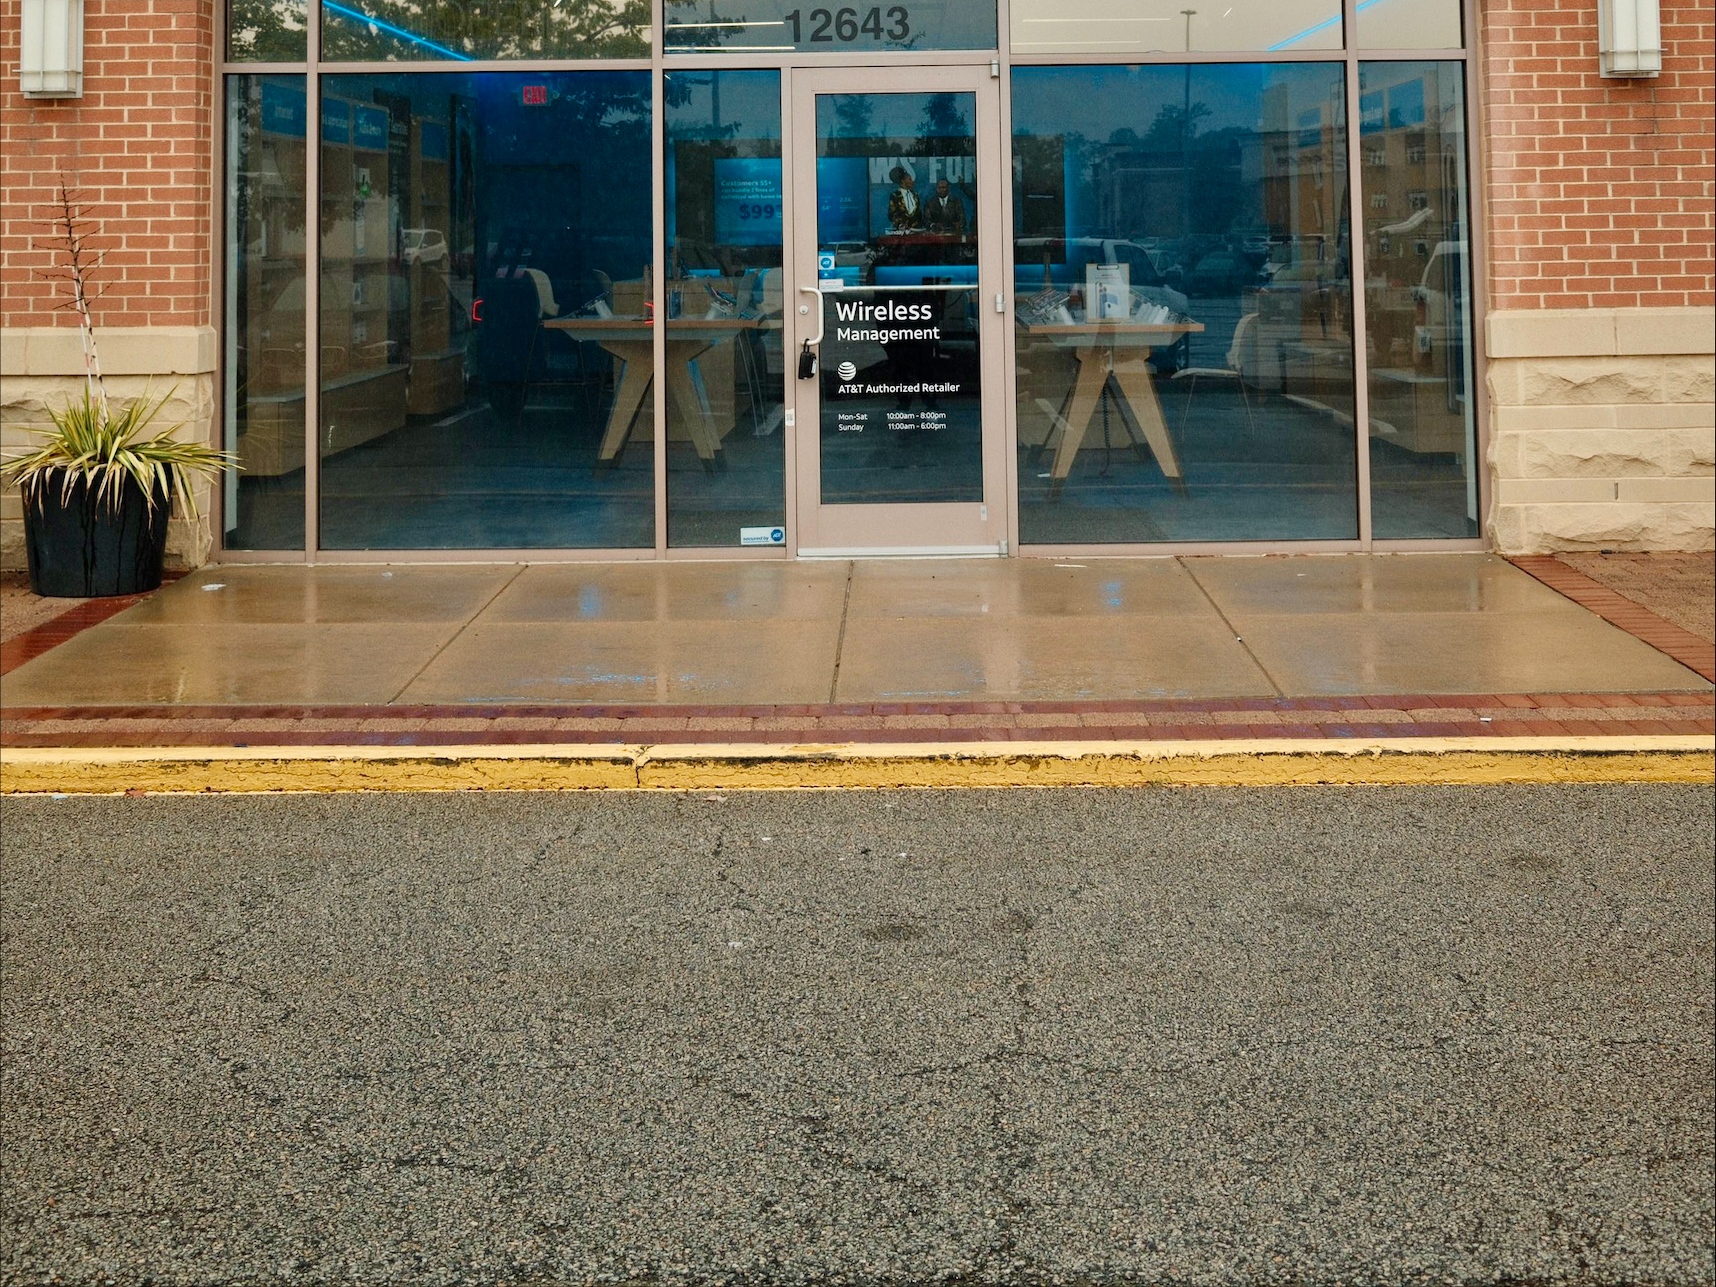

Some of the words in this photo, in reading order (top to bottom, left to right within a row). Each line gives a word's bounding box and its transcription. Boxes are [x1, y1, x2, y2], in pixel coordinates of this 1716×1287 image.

[785, 6, 910, 43] 12643
[523, 85, 547, 105] EXIT
[835, 300, 932, 322] Wireless
[837, 326, 941, 344] Management
[838, 384, 864, 394] AT&T
[865, 383, 920, 393] Authorized
[922, 382, 960, 393] Retailer
[838, 413, 868, 421] Mon-Sat
[887, 412, 915, 420] 10:00am
[920, 412, 947, 421] 8:00pm
[838, 424, 865, 433] Sunday
[920, 423, 947, 431] 6:00pm
